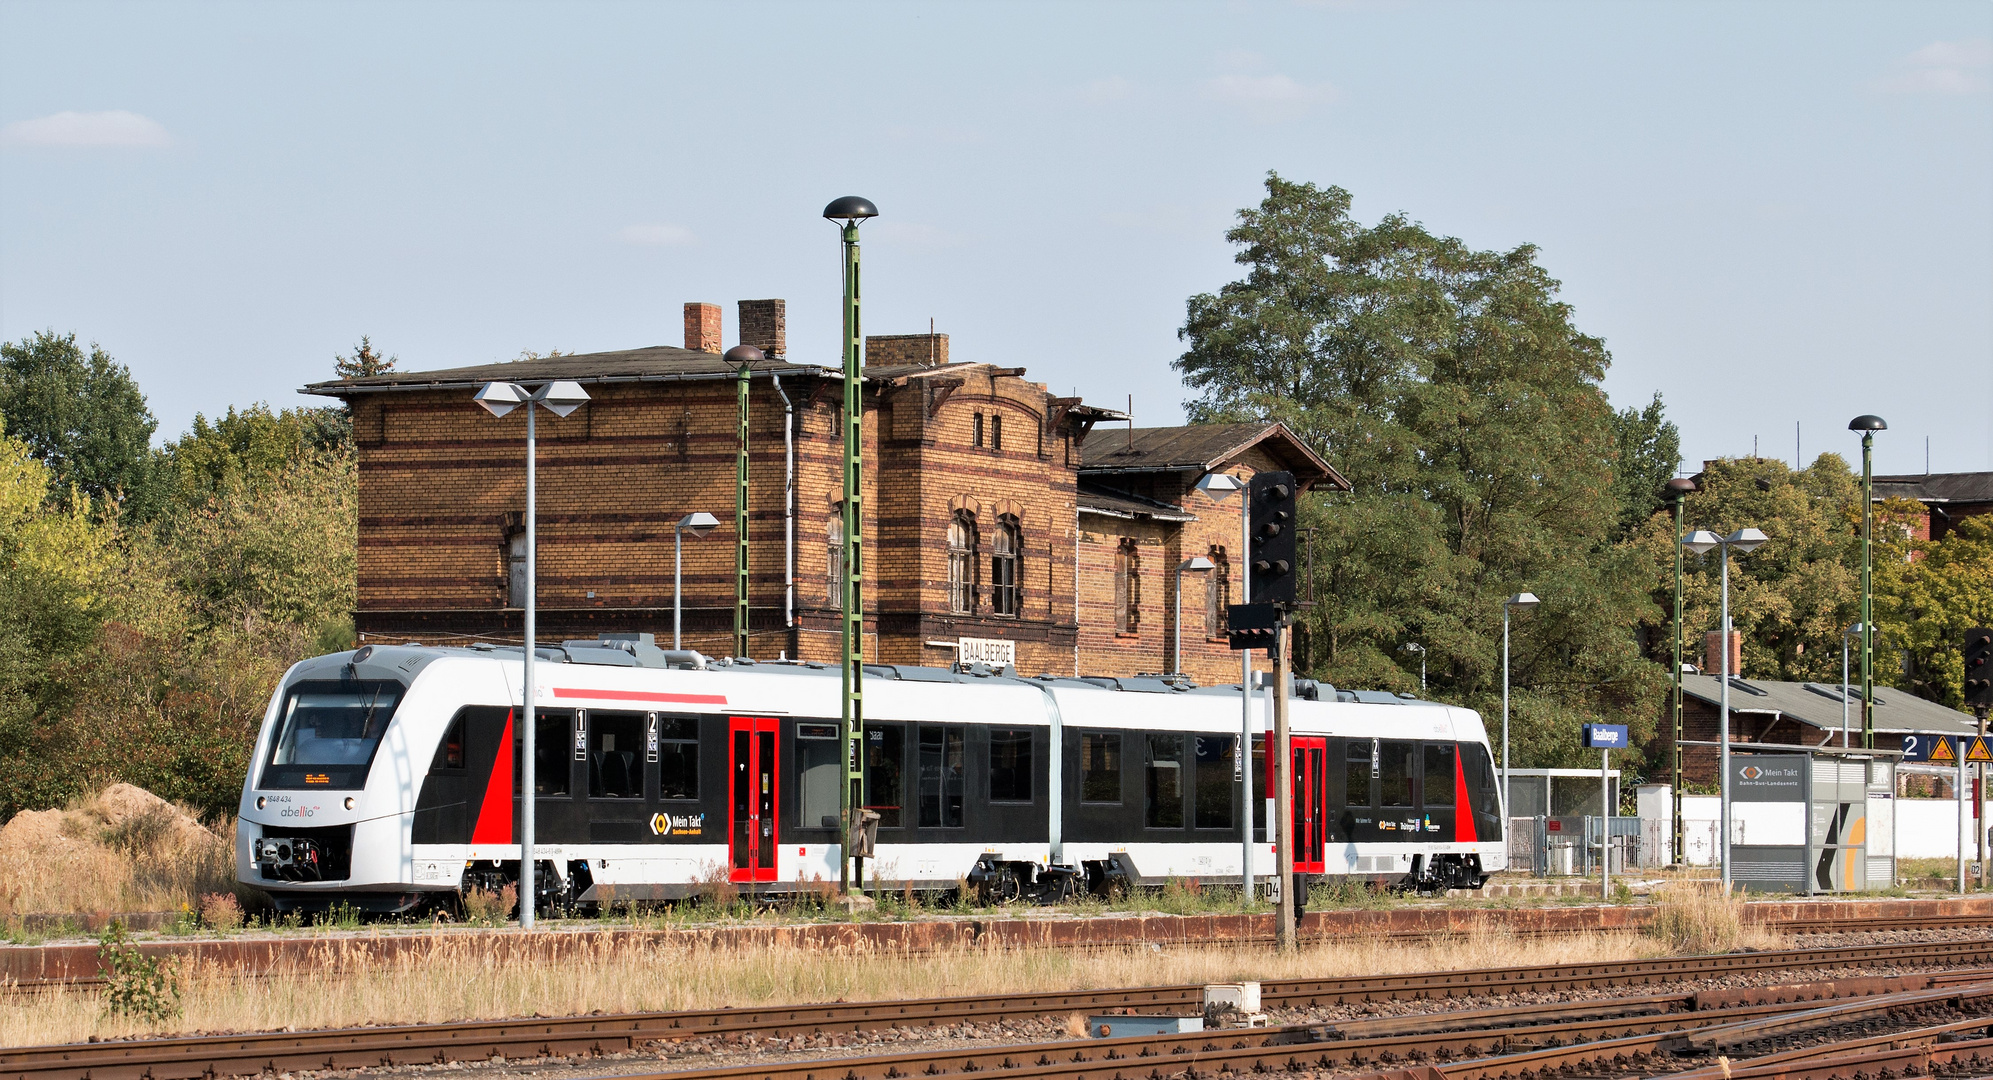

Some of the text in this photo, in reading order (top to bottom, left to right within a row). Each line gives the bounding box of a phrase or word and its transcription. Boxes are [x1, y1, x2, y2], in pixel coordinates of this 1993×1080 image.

[964, 642, 1010, 662] BAALBERGE
[578, 710, 583, 731] 1
[649, 712, 656, 732] 2
[1236, 734, 1241, 751] 2
[1593, 728, 1618, 743] Baalberge
[1373, 739, 1378, 755] 2
[1904, 735, 1918, 756] 2
[1765, 769, 1798, 777] Mein Takt
[280, 806, 314, 818] abellio
[673, 815, 701, 827] Mein Takt
[1266, 882, 1279, 897] D4
